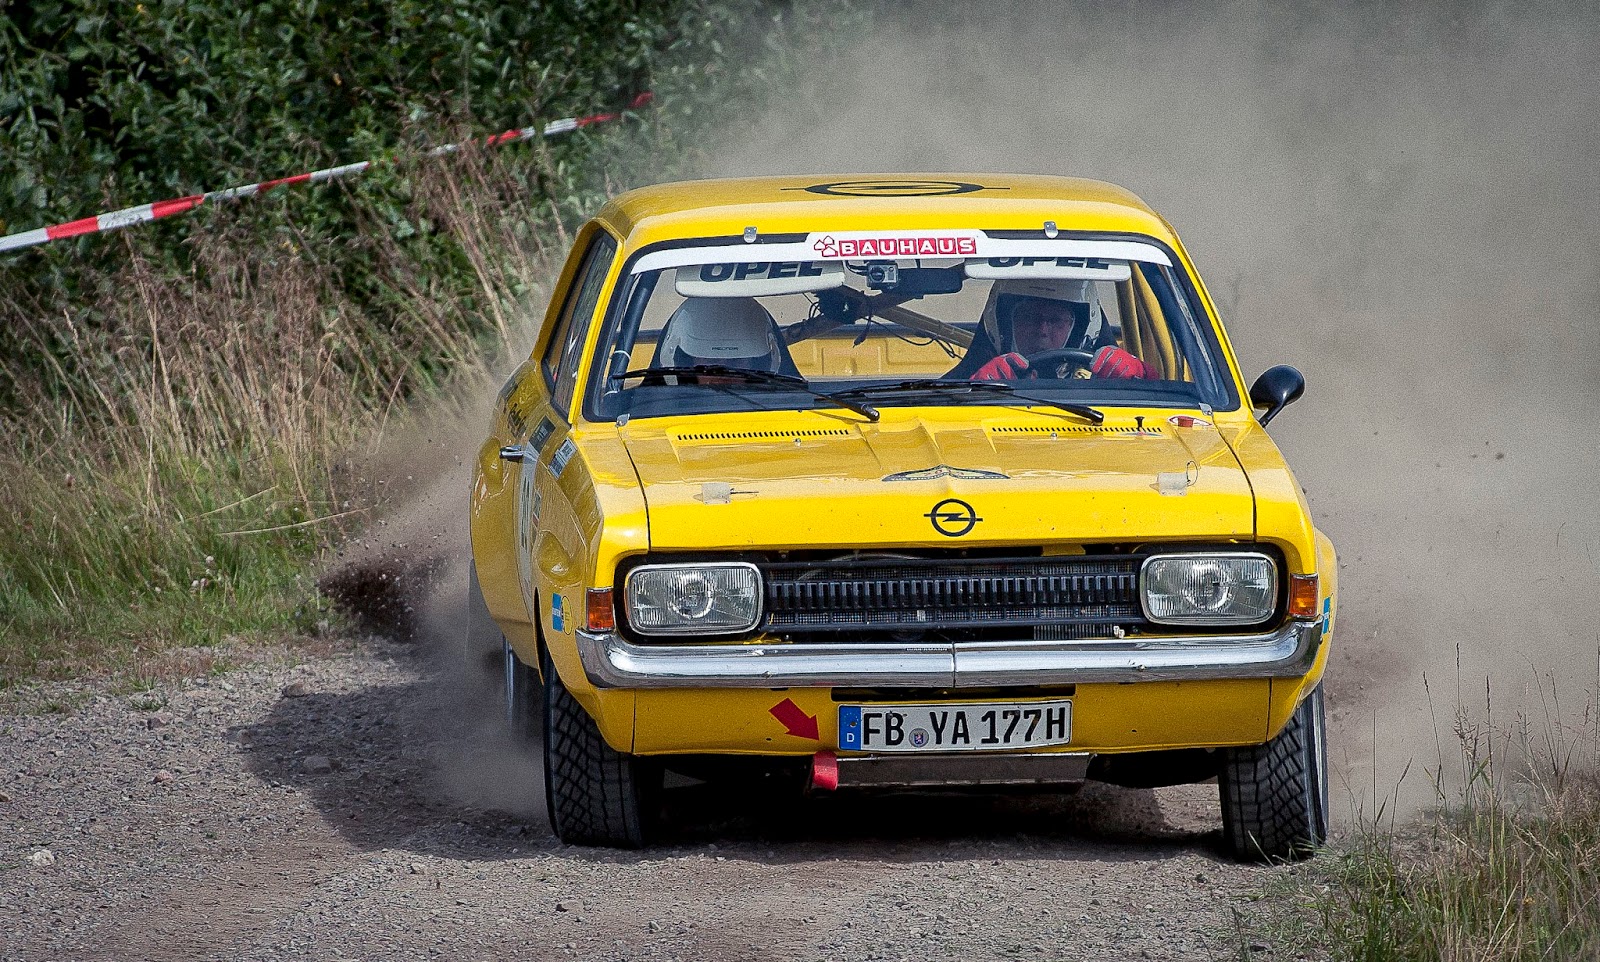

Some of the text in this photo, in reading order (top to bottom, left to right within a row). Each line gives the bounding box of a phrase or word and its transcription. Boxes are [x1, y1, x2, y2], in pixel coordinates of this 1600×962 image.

[840, 239, 975, 255] BAUHAUS
[699, 261, 823, 283] OPEL
[863, 707, 1066, 746] FB YA 177H
[846, 732, 855, 743] D
